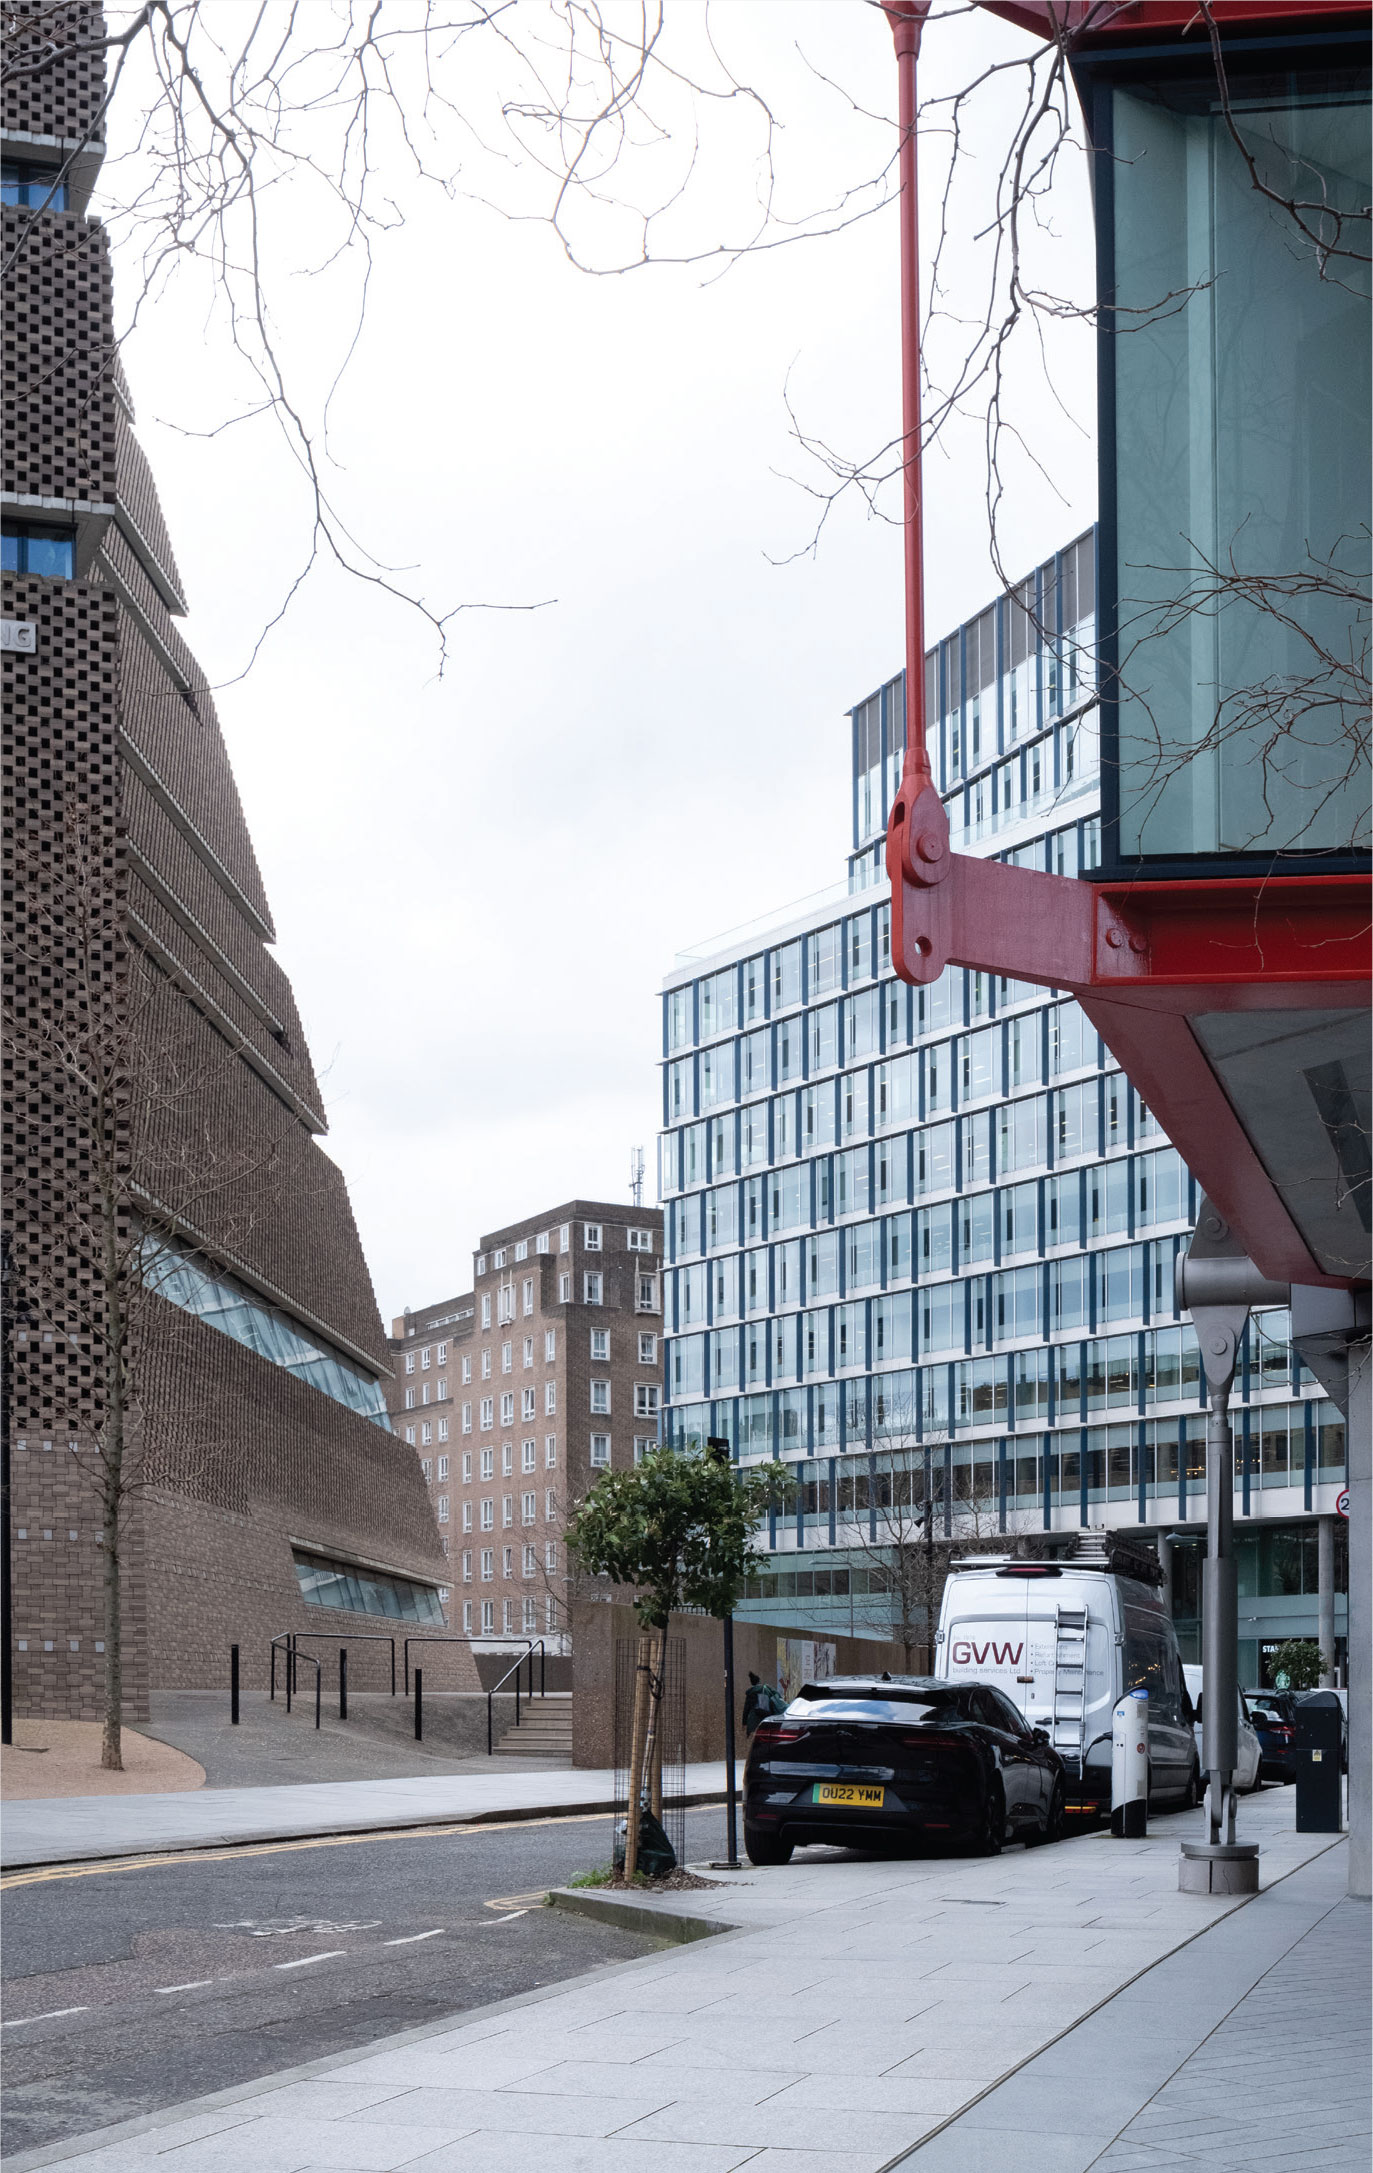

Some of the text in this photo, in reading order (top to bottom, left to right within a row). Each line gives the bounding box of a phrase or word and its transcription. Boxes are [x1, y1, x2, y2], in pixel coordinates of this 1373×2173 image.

[1340, 1498, 1350, 1510] 2
[952, 1641, 1024, 1665] GVW
[858, 1789, 882, 1801] YMM
